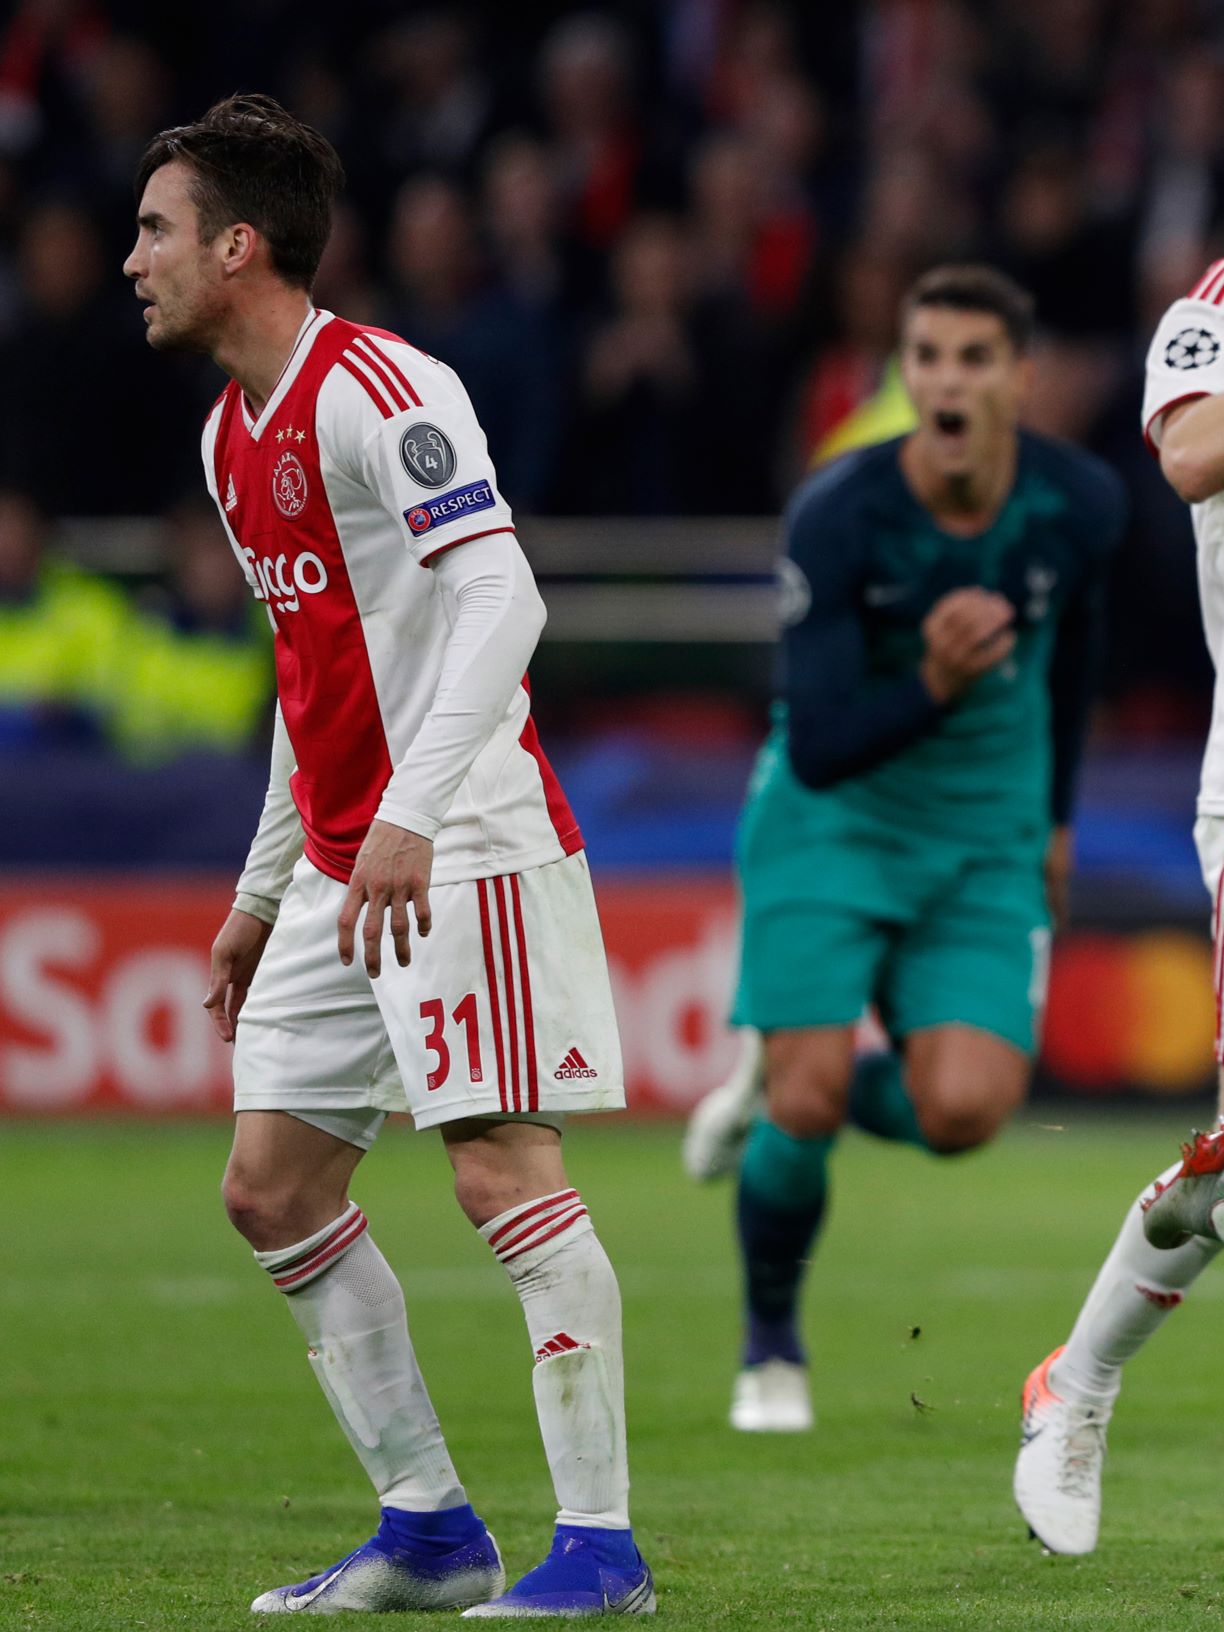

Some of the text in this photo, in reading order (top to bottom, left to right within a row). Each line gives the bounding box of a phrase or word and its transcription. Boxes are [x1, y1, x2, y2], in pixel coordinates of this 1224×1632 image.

[425, 455, 438, 469] 4
[430, 487, 490, 519] RESPECT
[419, 992, 484, 1091] 31
[553, 1067, 598, 1080] adidas
